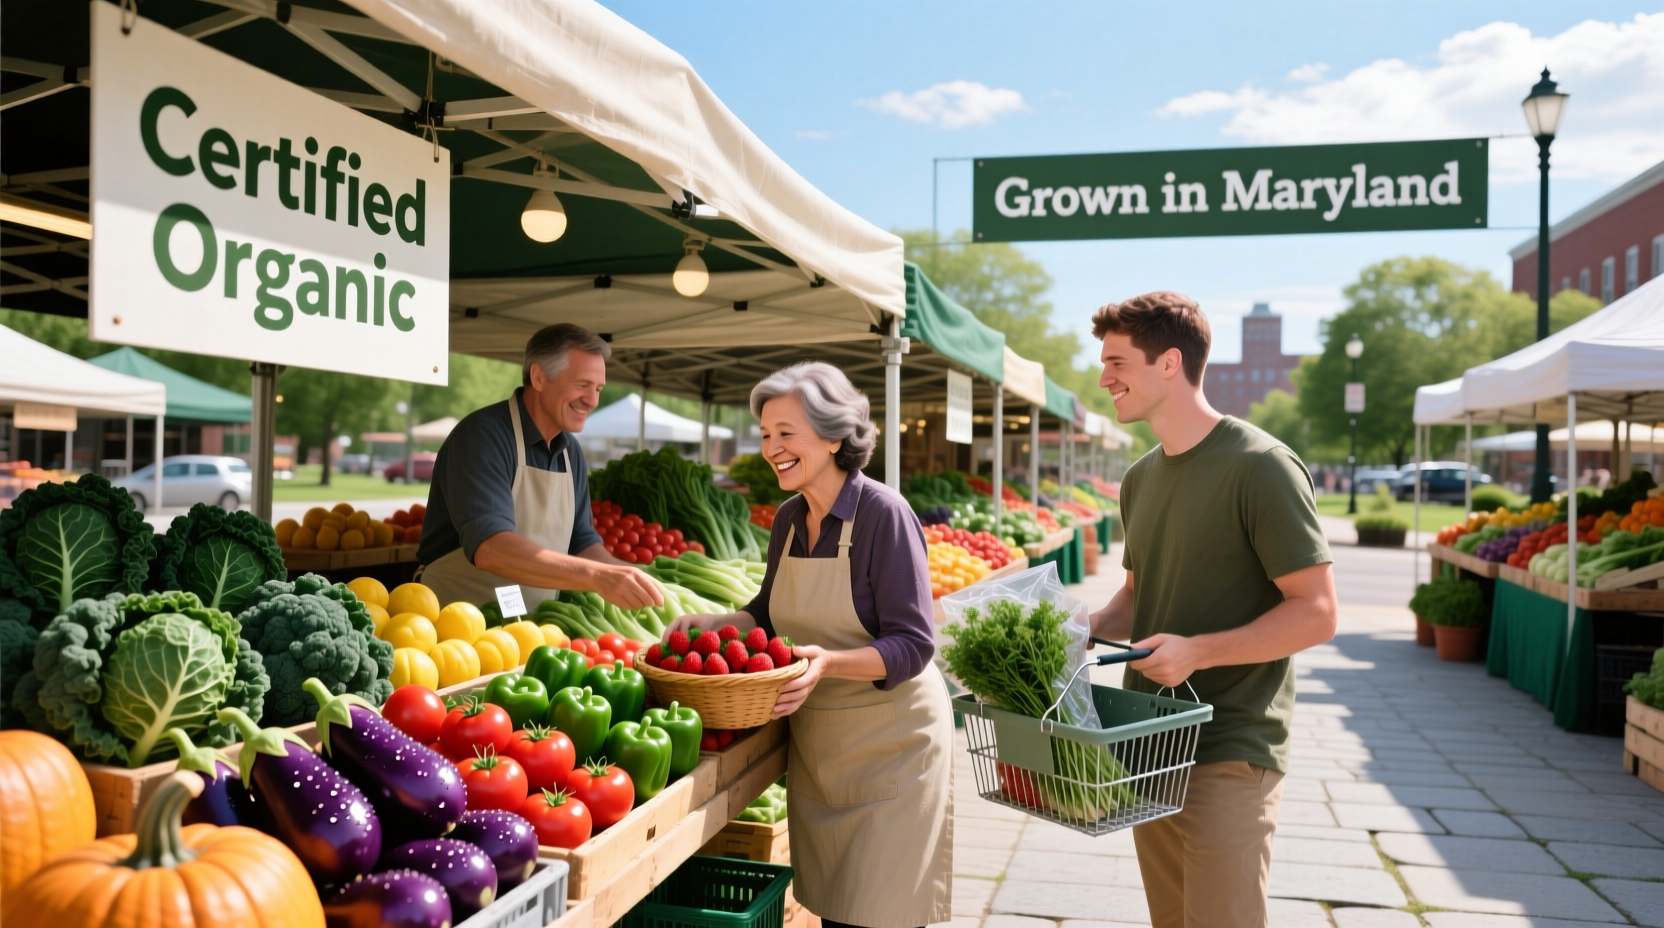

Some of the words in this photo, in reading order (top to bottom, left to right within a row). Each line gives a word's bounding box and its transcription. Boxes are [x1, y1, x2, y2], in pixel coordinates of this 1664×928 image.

[140, 86, 426, 247] Certified
[995, 176, 1149, 218] Grown
[1161, 171, 1208, 214] in
[1221, 160, 1462, 221] Maryland
[153, 203, 416, 332] Organic
